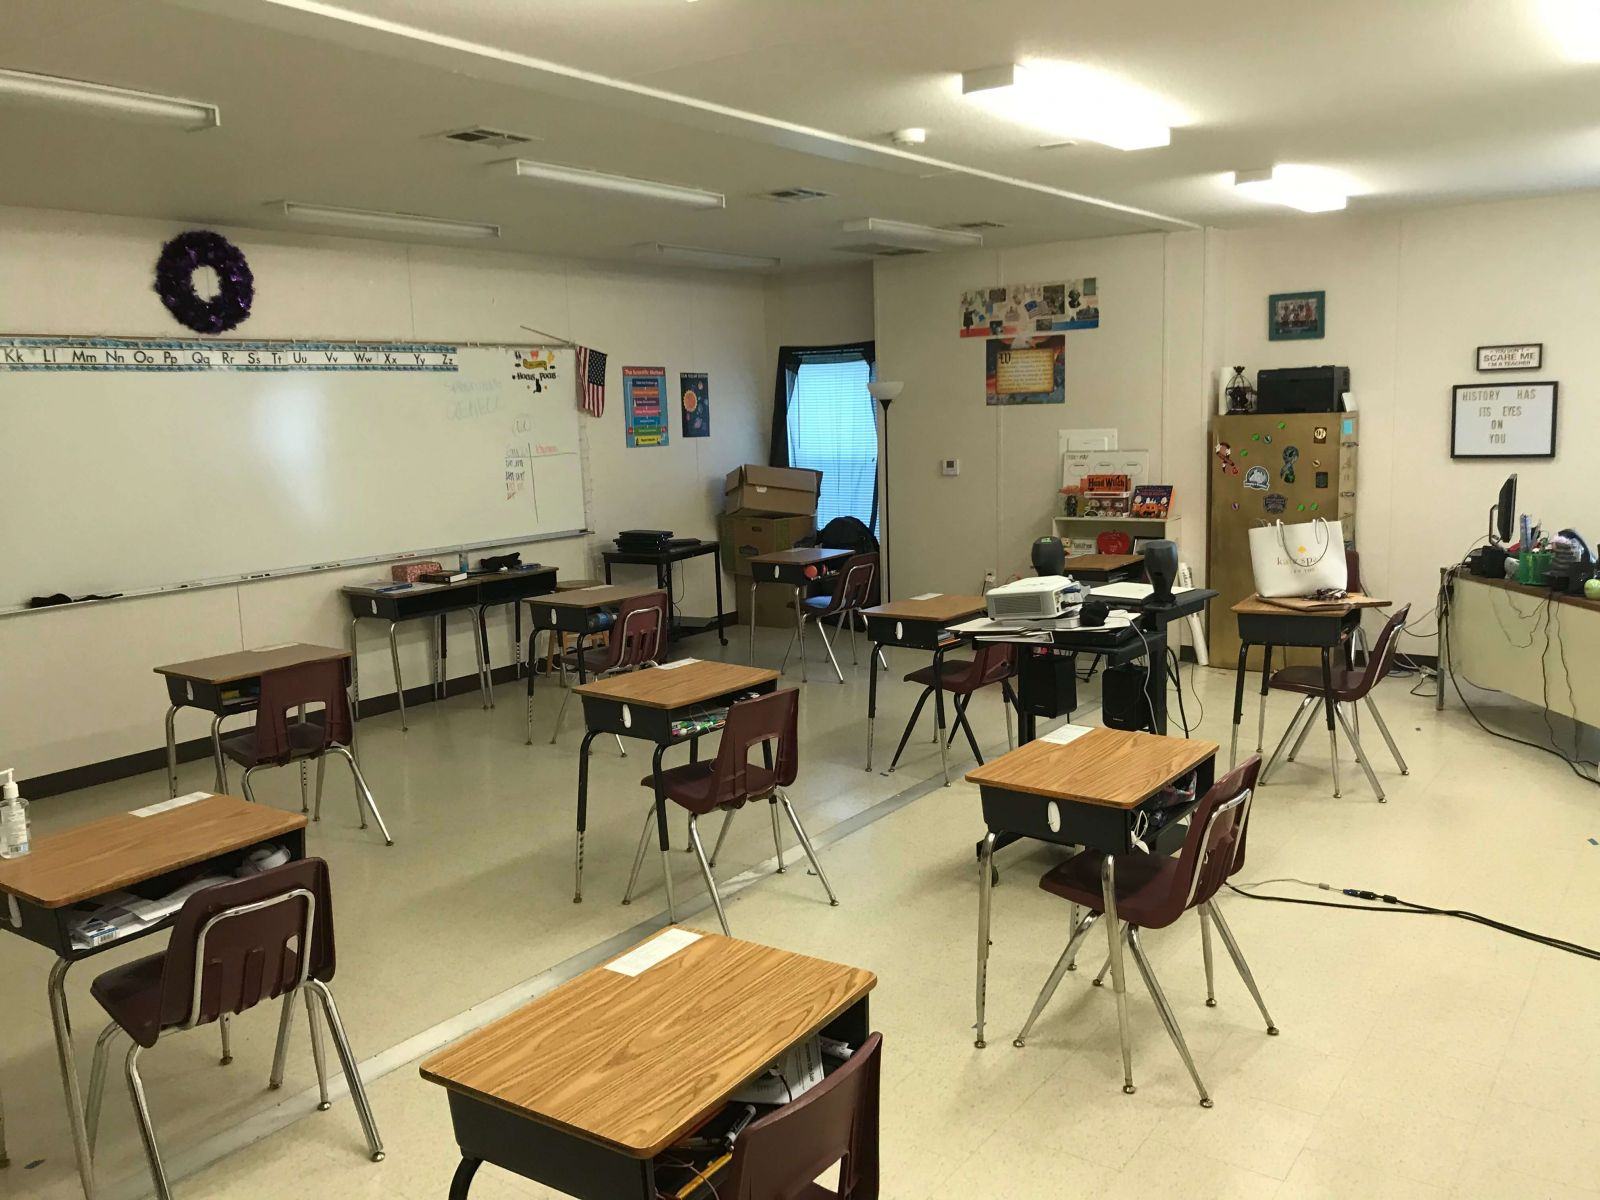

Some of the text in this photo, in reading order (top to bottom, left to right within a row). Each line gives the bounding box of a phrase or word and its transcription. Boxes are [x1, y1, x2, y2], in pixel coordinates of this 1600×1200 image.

[4, 349, 24, 363] Kk
[72, 350, 97, 363] Mm
[105, 351, 125, 363] Nn
[133, 350, 154, 364] Oo
[163, 351, 178, 366] Pp
[222, 351, 235, 364] Rr
[247, 352, 261, 364] Ss
[271, 352, 282, 364] Tt
[293, 352, 308, 364] Uu
[324, 352, 338, 363] Vv
[354, 352, 372, 363] Ww
[384, 353, 397, 364] Xx
[413, 353, 426, 366] Yy
[442, 353, 453, 365] Zz
[1483, 352, 1536, 361] SCARE ME
[1462, 389, 1536, 401] HISTORY HAS
[1479, 406, 1522, 417] ITS EYES
[1491, 420, 1503, 430] ON
[1489, 434, 1506, 444] YOU
